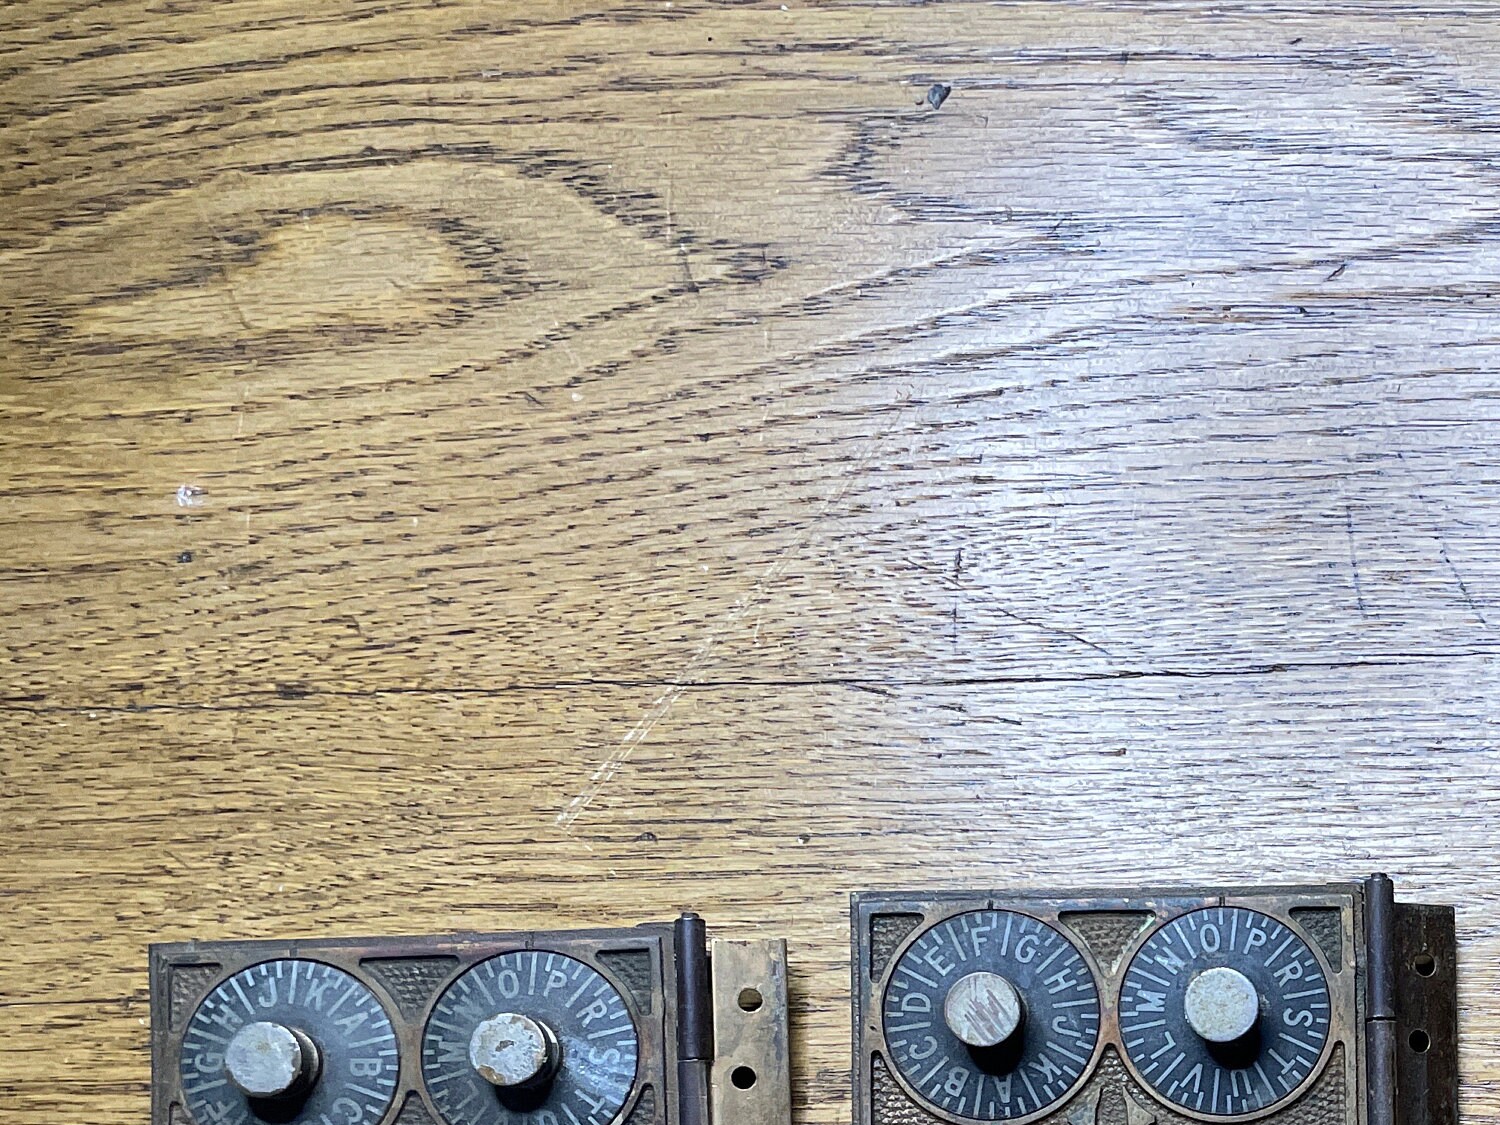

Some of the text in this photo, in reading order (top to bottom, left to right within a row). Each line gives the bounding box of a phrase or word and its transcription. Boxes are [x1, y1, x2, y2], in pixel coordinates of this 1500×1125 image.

[258, 977, 278, 1008] J
[304, 978, 335, 1011] K
[498, 969, 520, 999] O
[543, 970, 568, 998] P
[334, 1011, 368, 1036] A
[575, 1000, 607, 1028] R
[901, 926, 1081, 1103] D E F G H J K A B C
[1136, 924, 1313, 1098] M N O P R S T U V L
[438, 1041, 470, 1062] M
[349, 1058, 383, 1077] B
[332, 1097, 363, 1125] C
[574, 1088, 605, 1114] T
